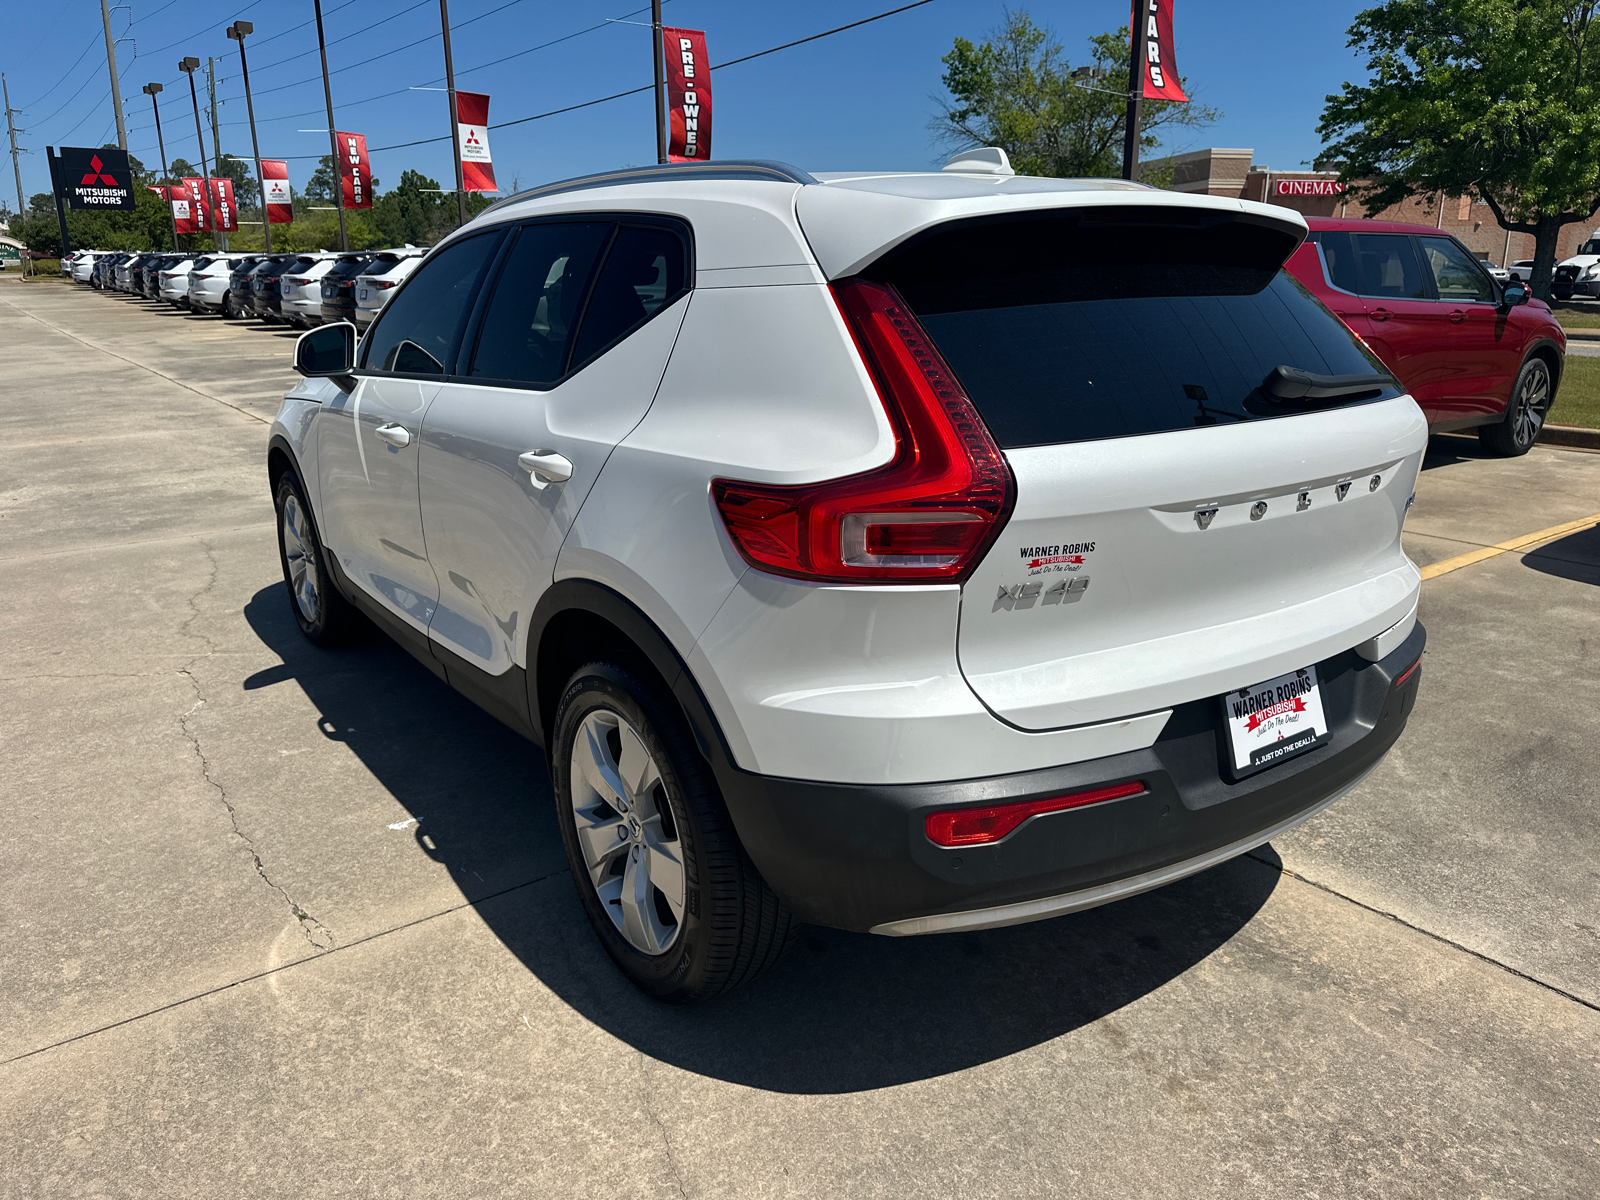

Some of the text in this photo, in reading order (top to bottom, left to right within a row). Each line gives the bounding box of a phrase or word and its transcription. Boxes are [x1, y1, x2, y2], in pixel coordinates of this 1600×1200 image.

[679, 38, 700, 157] PRE-OWNED
[347, 138, 362, 203] NEW CARS
[75, 187, 127, 197] MITSUBISHI
[83, 196, 122, 205] MOTORS
[1279, 181, 1342, 195] CINEMAS
[190, 181, 204, 228] NEW CARS
[1194, 474, 1381, 530] VOLVO
[1020, 541, 1096, 558] WARNER ROBINS
[1038, 555, 1076, 565] MITSUBISHI
[1028, 567, 1042, 577] Just
[1043, 566, 1051, 574] Do
[1232, 675, 1312, 720] WARNER ROBINS
[1255, 699, 1296, 723] MITSUBISHI
[1256, 713, 1300, 738] Just Do The Deal!
[1260, 737, 1311, 763] JUST DO THE DEAL!
[655, 751, 700, 885] MICHELIN
